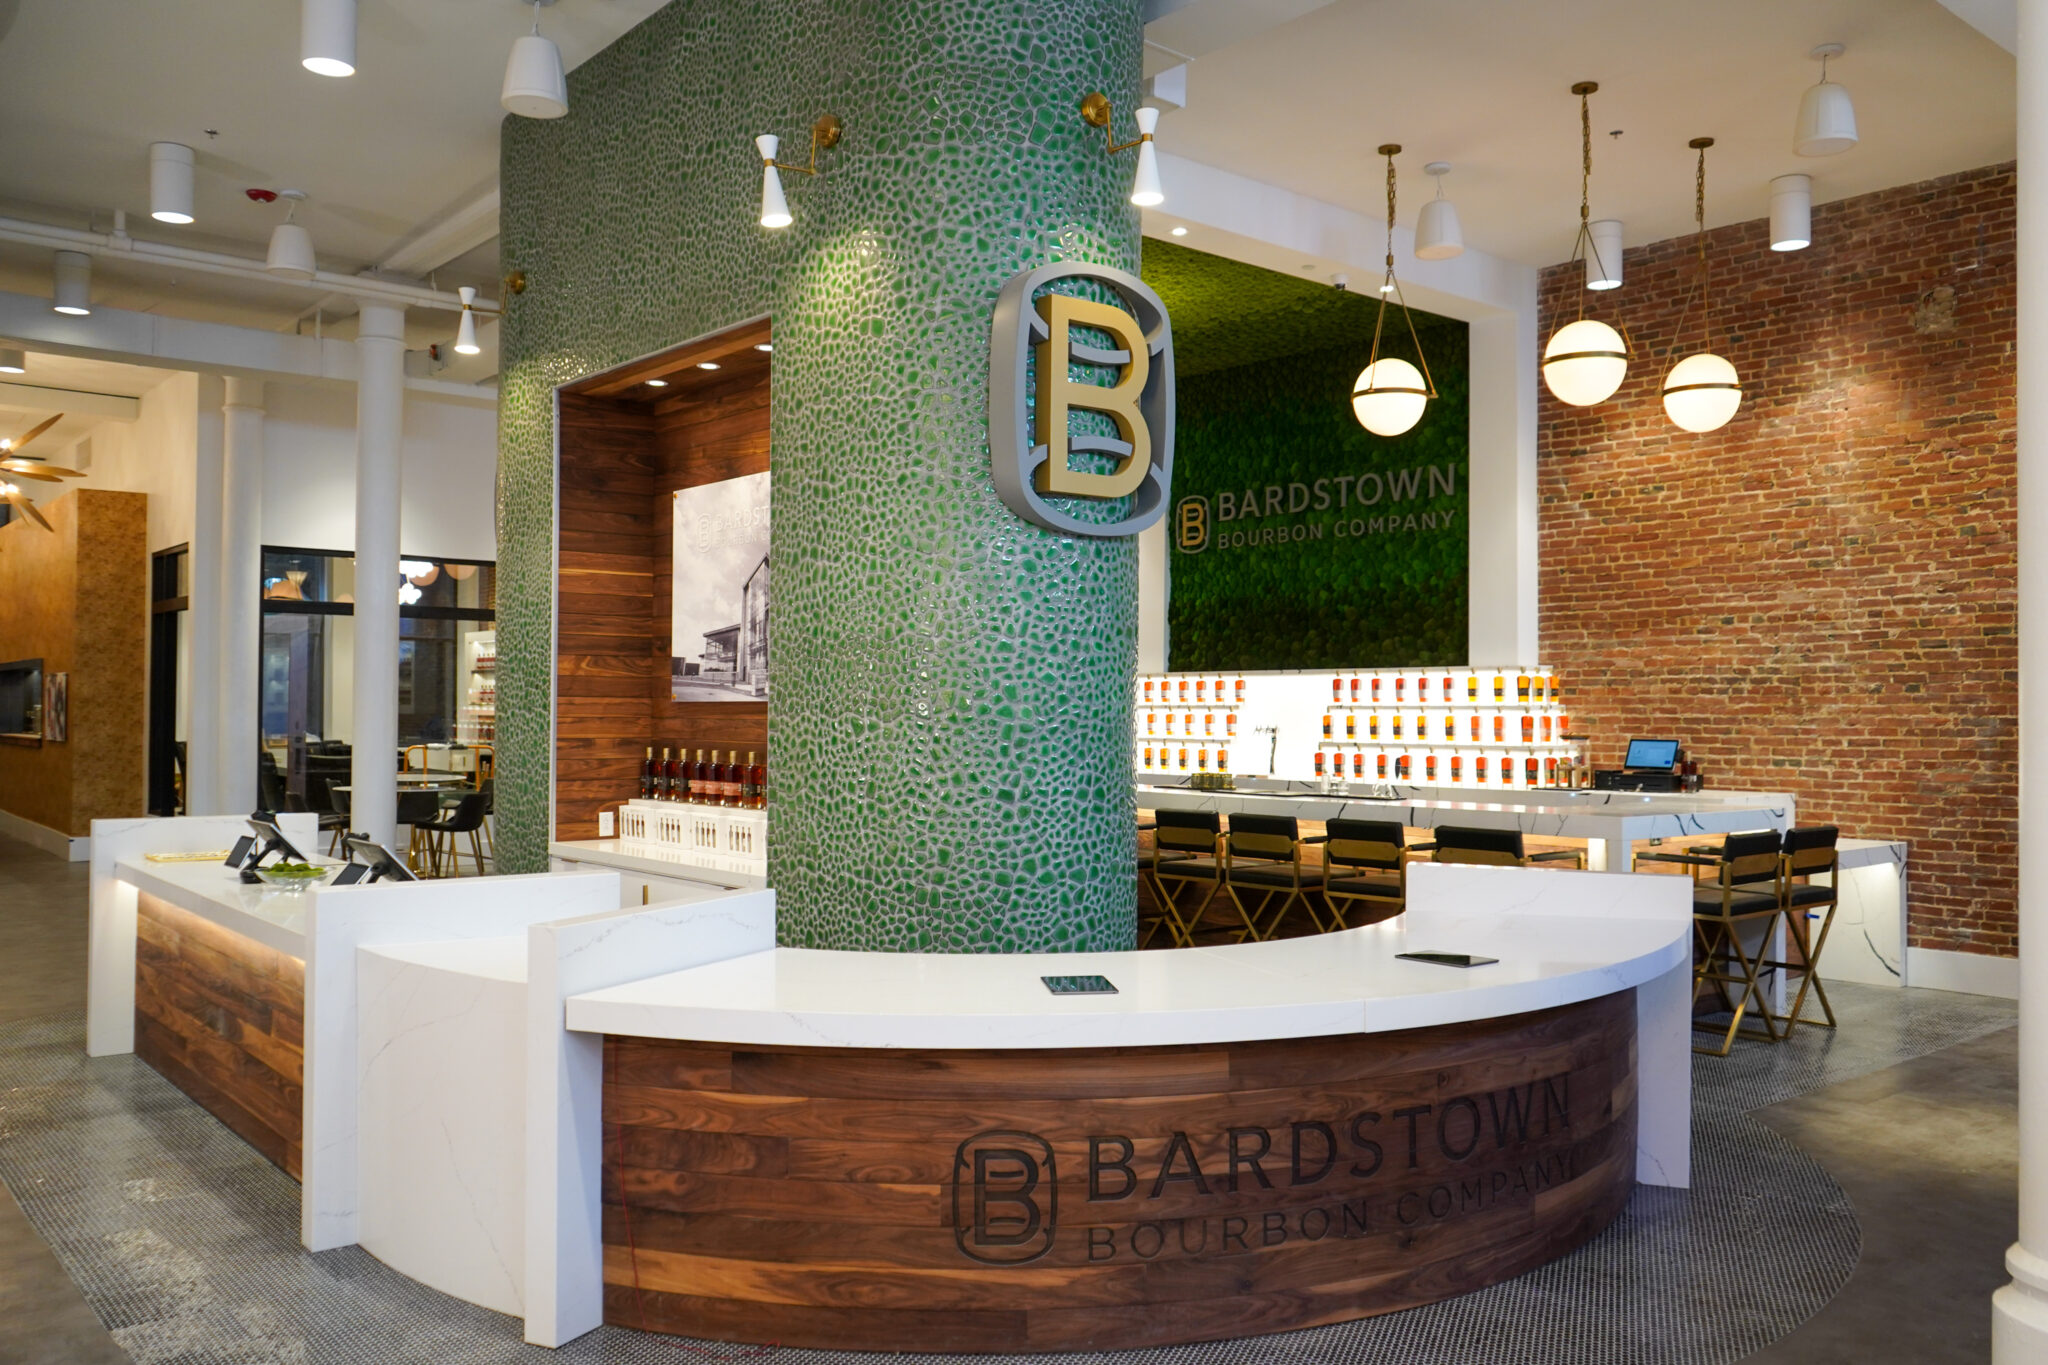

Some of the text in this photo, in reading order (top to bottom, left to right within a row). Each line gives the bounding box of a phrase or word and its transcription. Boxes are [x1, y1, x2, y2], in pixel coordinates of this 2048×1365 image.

[1036, 294, 1151, 498] B
[1218, 463, 1456, 522] BARDSTOWN
[1218, 510, 1455, 549] BOURBON COMPANY
[1087, 1072, 1570, 1202] BARDSTOWN
[1088, 1153, 1573, 1263] BOURBON COMPANY
